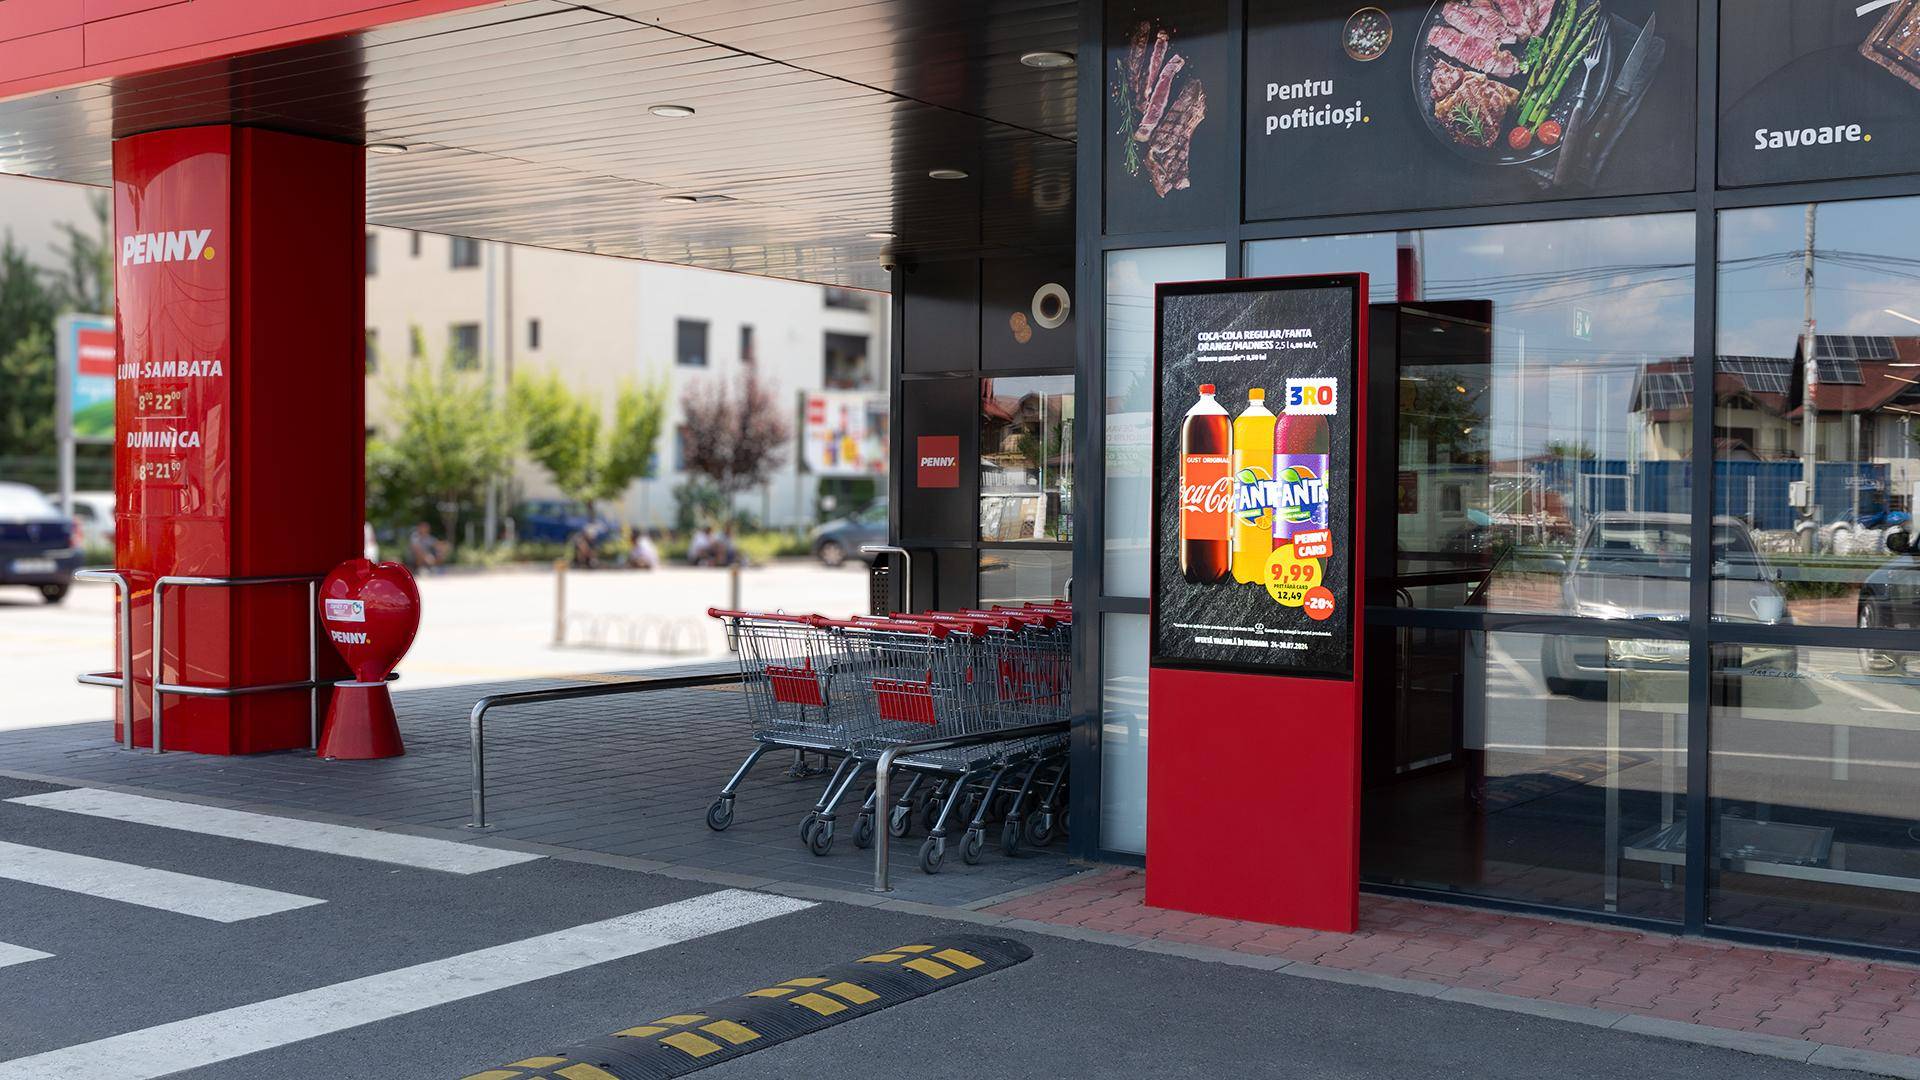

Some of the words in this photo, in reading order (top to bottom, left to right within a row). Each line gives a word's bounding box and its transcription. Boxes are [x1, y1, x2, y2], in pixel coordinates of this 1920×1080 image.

[1266, 79, 1334, 102] Pentru
[1266, 100, 1370, 135] pofticioși.
[1754, 123, 1872, 150] Savoare.
[122, 228, 215, 267] PENNY.
[1197, 330, 1243, 341] COCA-COLA
[1243, 328, 1313, 340] REGULAR/FANTA
[1197, 341, 1274, 352] ORANGE/MADNESS
[1275, 341, 1286, 350] 2,5
[117, 360, 223, 380] LUNI-SAMBATA
[1290, 385, 1333, 406] 3RO
[127, 431, 200, 448] DUMINICA
[920, 457, 956, 467] PENNY.
[1298, 544, 1327, 557] CARD
[1271, 564, 1314, 583] 9,99
[1278, 591, 1302, 600] 12,49
[331, 630, 371, 645] PENNY.
